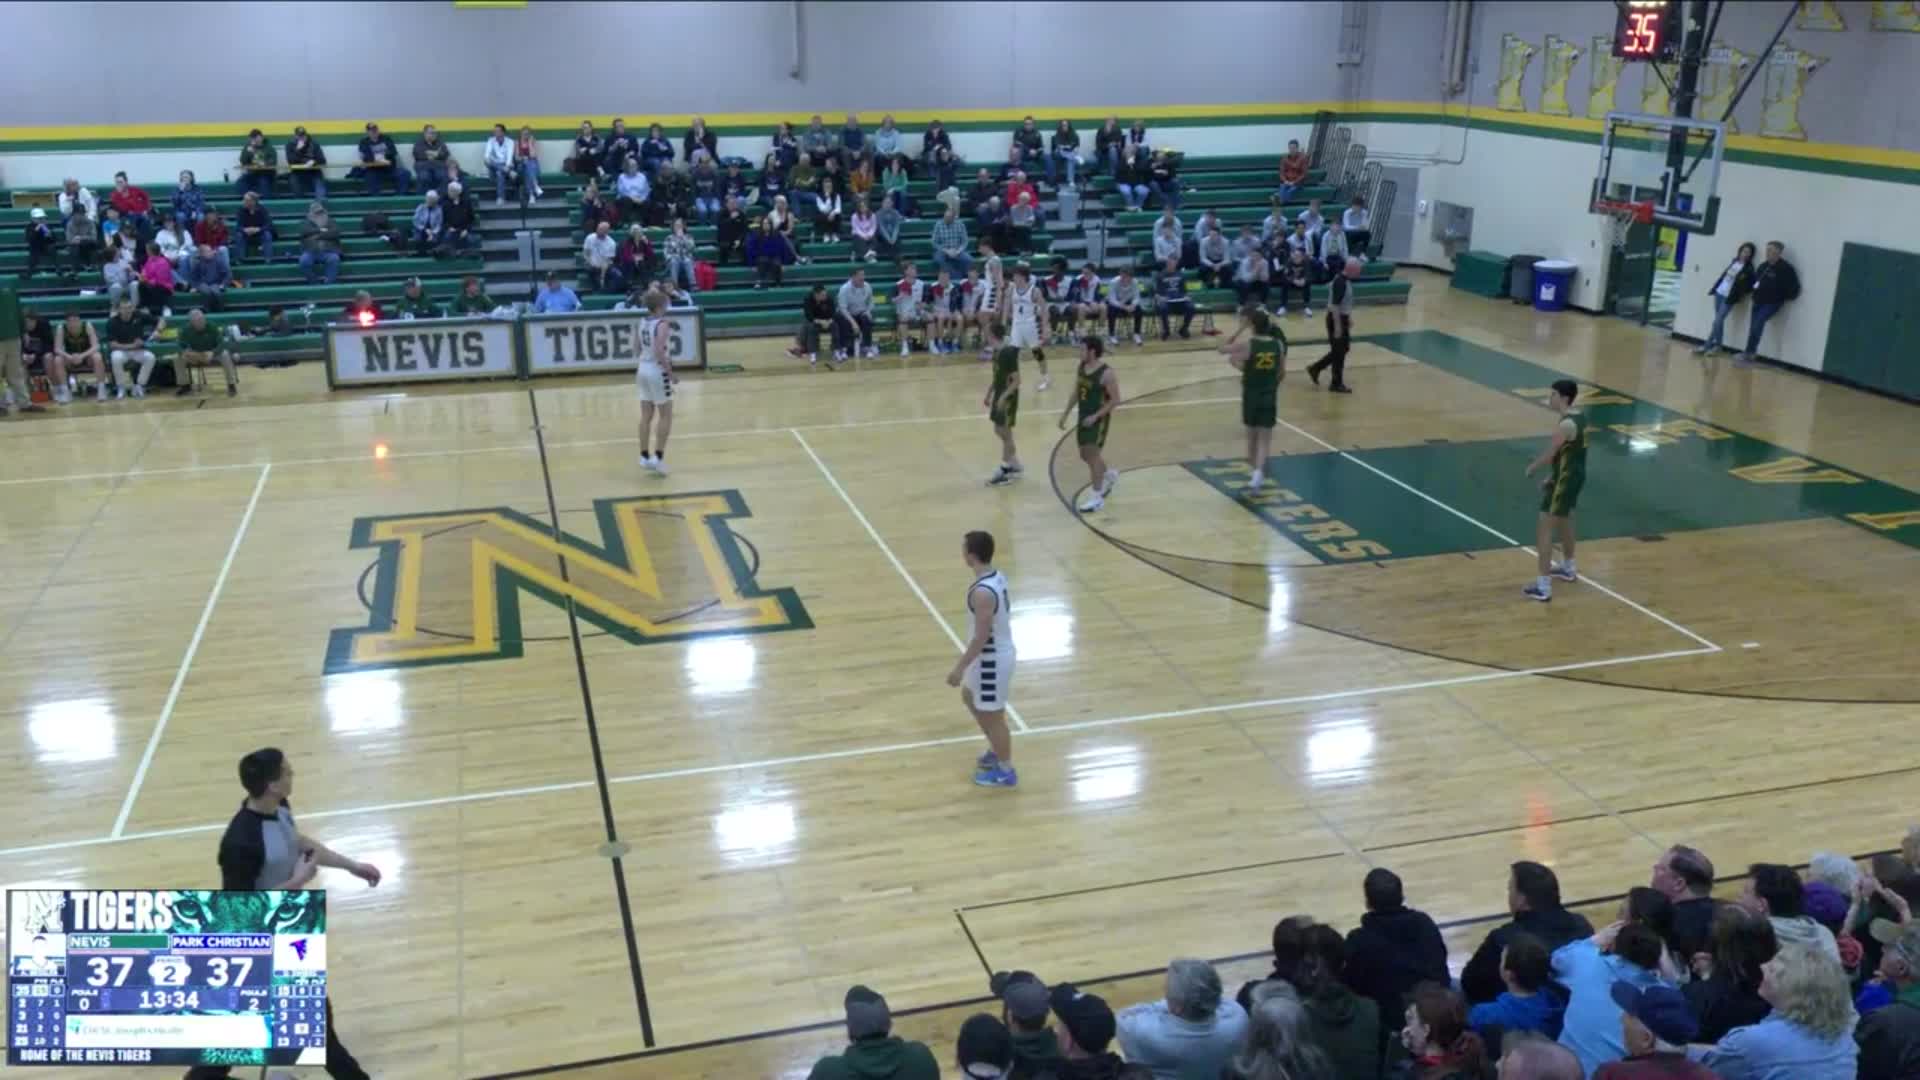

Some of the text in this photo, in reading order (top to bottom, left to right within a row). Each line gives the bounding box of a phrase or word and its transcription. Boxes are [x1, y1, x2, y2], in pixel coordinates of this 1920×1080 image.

[362, 331, 486, 373] NEVIS
[545, 320, 683, 363] TIGES
[1255, 351, 1275, 369] 25
[322, 489, 815, 674] N
